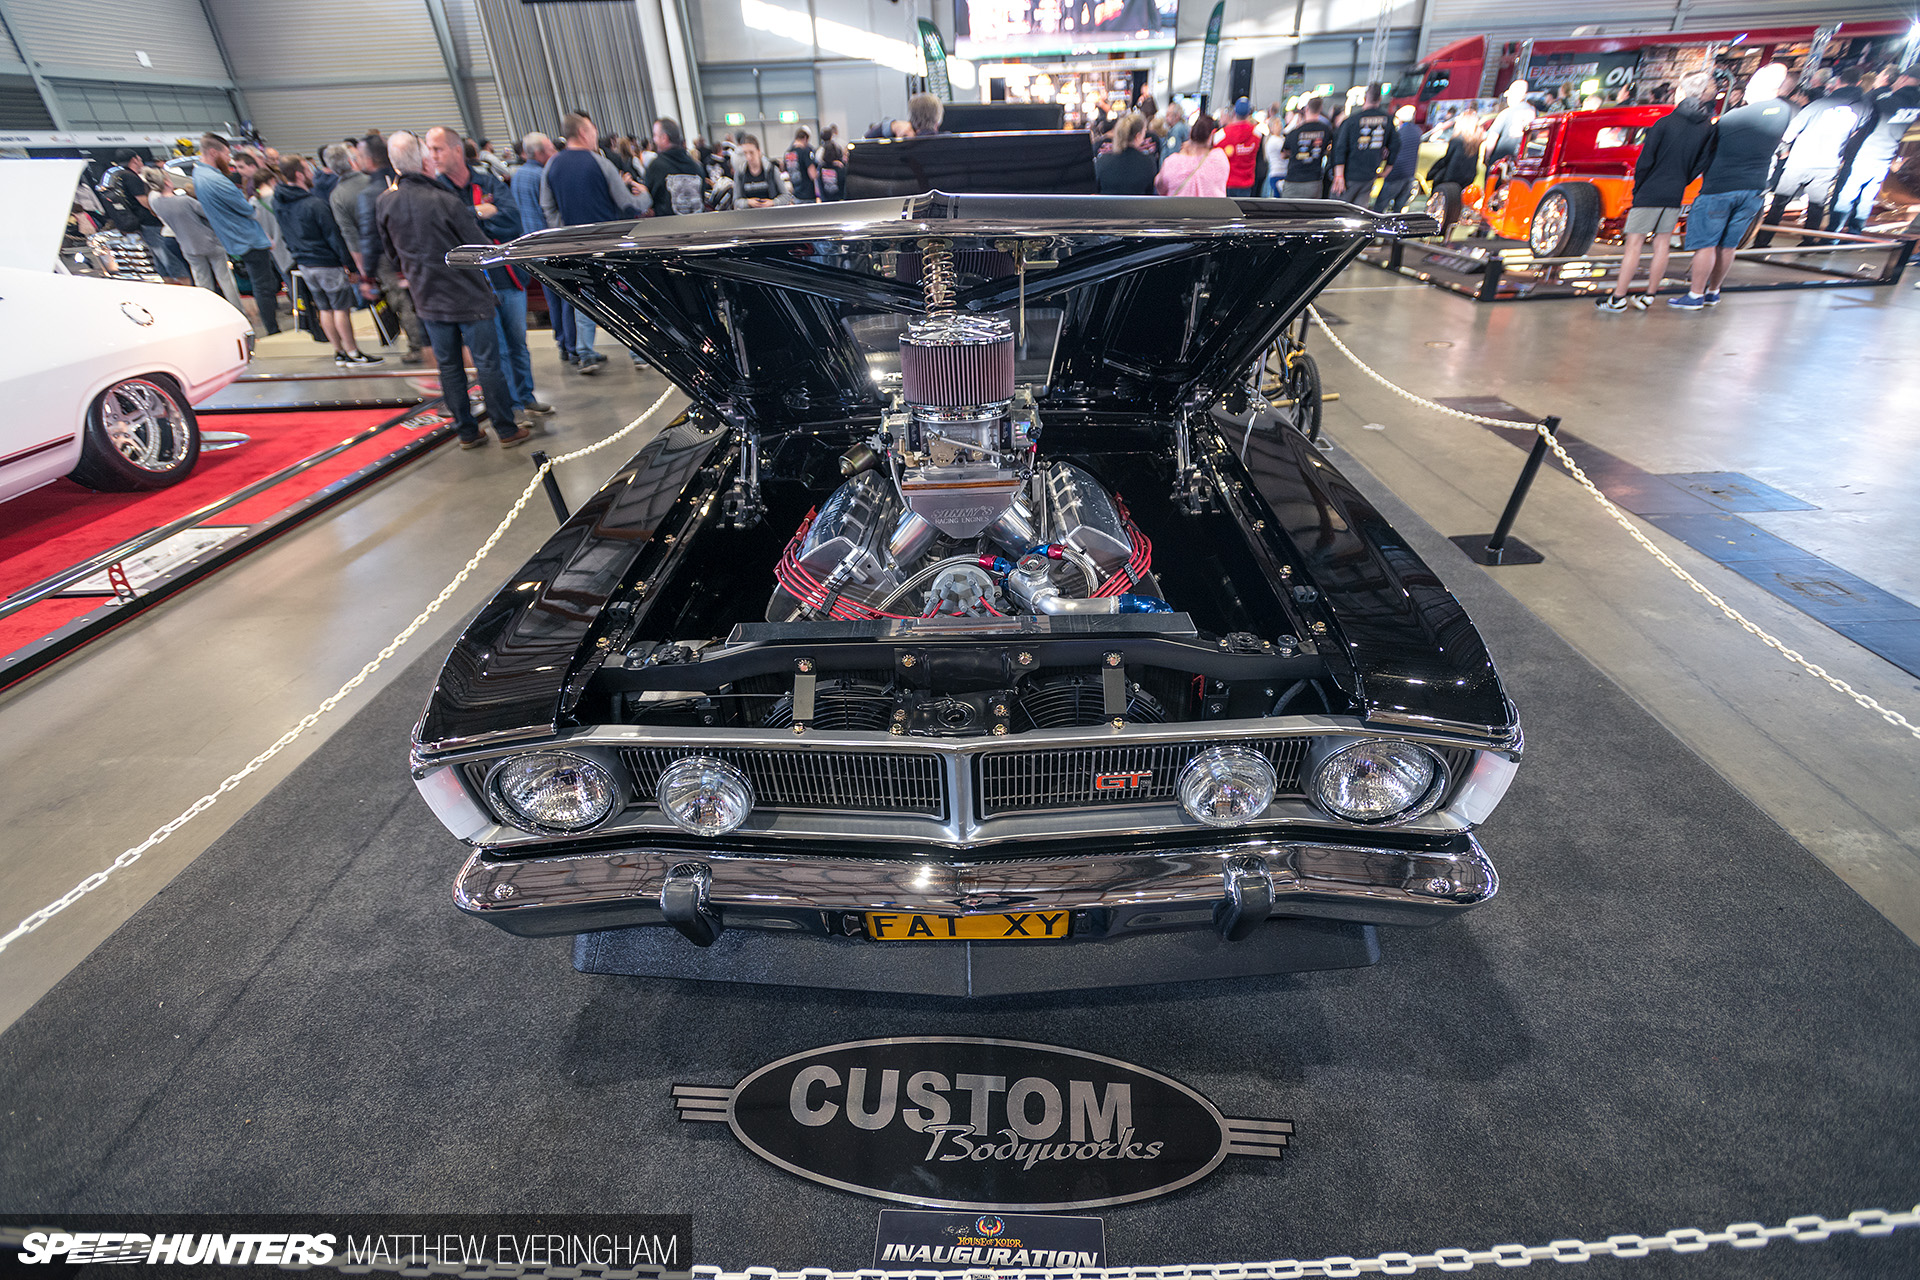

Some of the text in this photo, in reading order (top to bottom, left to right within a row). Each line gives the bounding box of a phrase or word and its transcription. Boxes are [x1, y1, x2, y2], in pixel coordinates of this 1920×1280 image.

[1529, 62, 1599, 77] EXCLUSIVE
[931, 505, 994, 518] SONNY'S
[961, 515, 990, 523] ENGINES
[1096, 770, 1152, 790] GT
[872, 912, 1065, 937] FAT XY
[789, 1064, 1133, 1143] CUSTOM
[923, 1124, 1164, 1171] Bodyworks
[956, 1236, 987, 1247] HOUSE
[994, 1237, 1024, 1248] KOLOR
[881, 1243, 1098, 1268] INAUGURATION
